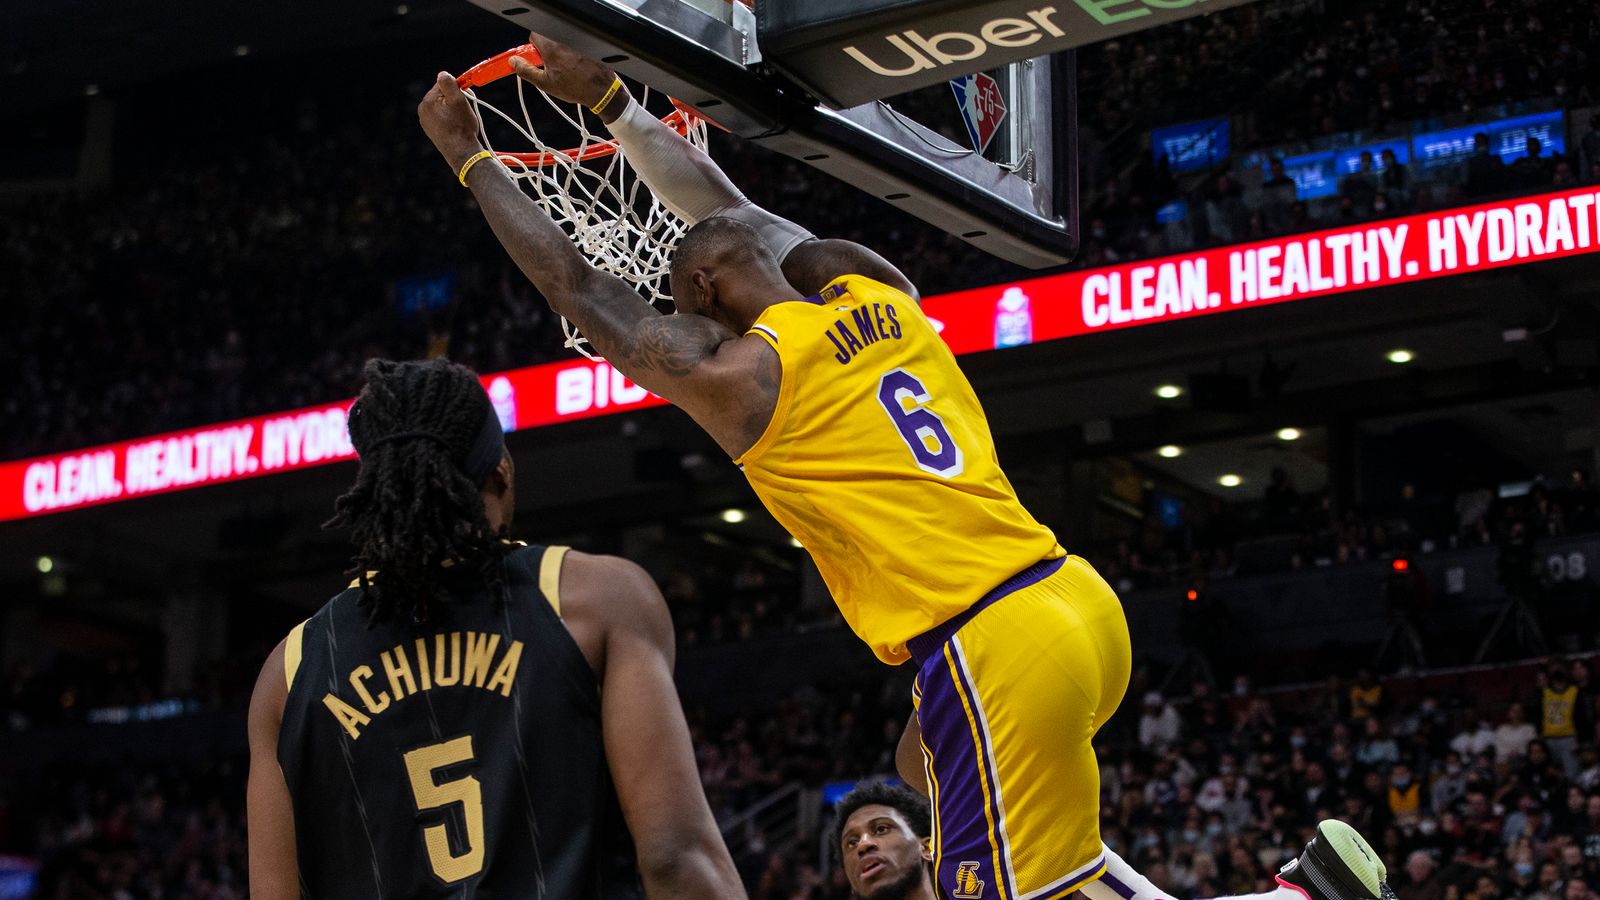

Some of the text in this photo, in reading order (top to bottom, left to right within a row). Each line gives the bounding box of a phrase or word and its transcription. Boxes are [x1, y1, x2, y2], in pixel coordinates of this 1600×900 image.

[843, 6, 1065, 77] Uber
[982, 87, 995, 115] 75
[1082, 257, 1221, 327] CLEAN.
[1229, 224, 1419, 304] HEALTHY.
[1427, 193, 1600, 272] HYDRAT
[825, 303, 902, 365] JAMES
[876, 367, 963, 478] 6
[24, 450, 122, 511] CLEAN.
[126, 424, 259, 494] HEALTHY.
[1536, 551, 1588, 585] 08
[322, 632, 524, 740] ACHIUWA
[403, 734, 486, 883] 5
